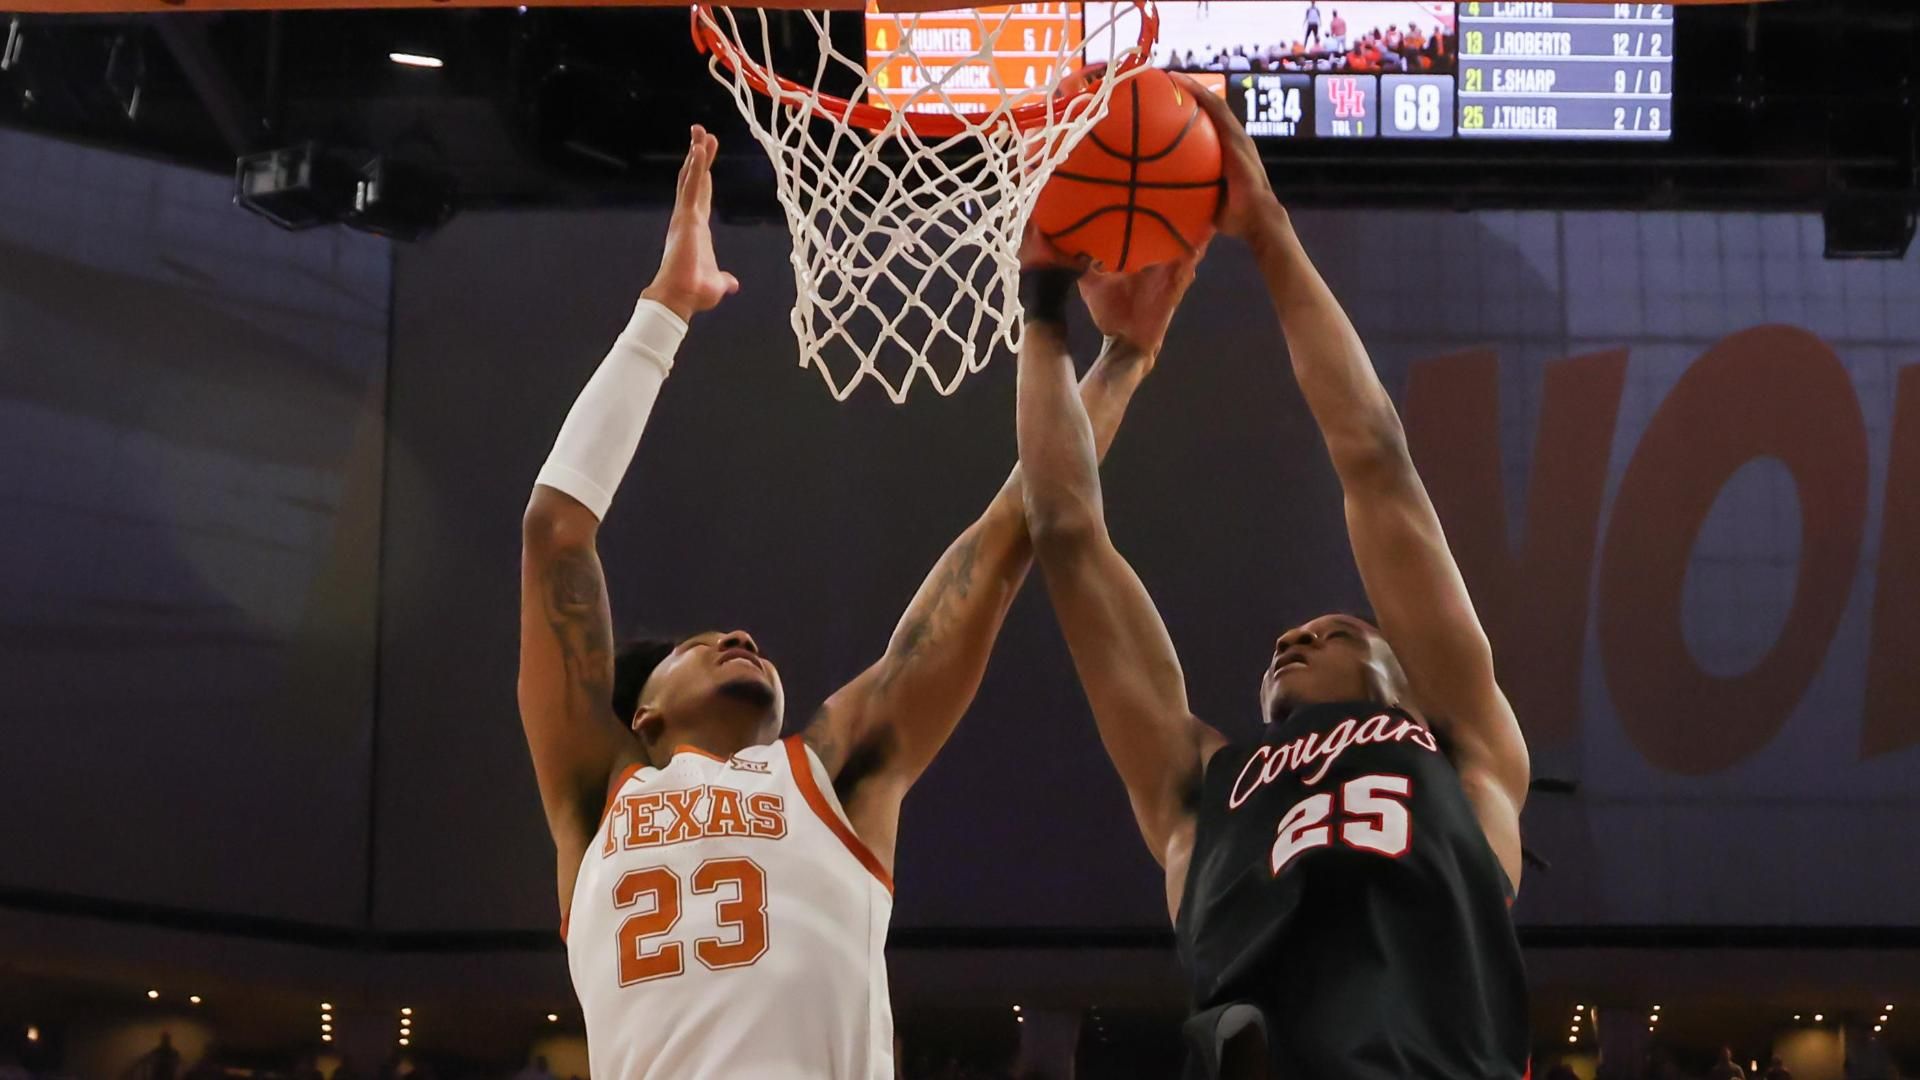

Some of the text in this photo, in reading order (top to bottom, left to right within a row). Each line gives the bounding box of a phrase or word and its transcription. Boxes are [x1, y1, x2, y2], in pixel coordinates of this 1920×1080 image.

[876, 28, 887, 50] 4
[1024, 28, 1036, 51] 5
[1465, 31, 1483, 54] 13
[1493, 31, 1572, 56] J.ROBERTS
[1613, 33, 1630, 56] 12
[1651, 33, 1662, 56] 2
[1465, 68, 1482, 91] 21
[1492, 69, 1556, 92] E.SHARP
[1614, 69, 1626, 93] 9
[1649, 70, 1661, 94] 0
[1244, 88, 1302, 122] 1:34
[1394, 84, 1440, 131] 68
[1463, 105, 1484, 129] 25
[1492, 106, 1557, 130] J.TUGLER
[1613, 107, 1625, 130] 2
[1648, 107, 1661, 130] 3
[1228, 713, 1438, 811] Cougars
[602, 784, 788, 859] TEXAS
[1270, 772, 1413, 877] 25
[612, 856, 769, 988] 23
